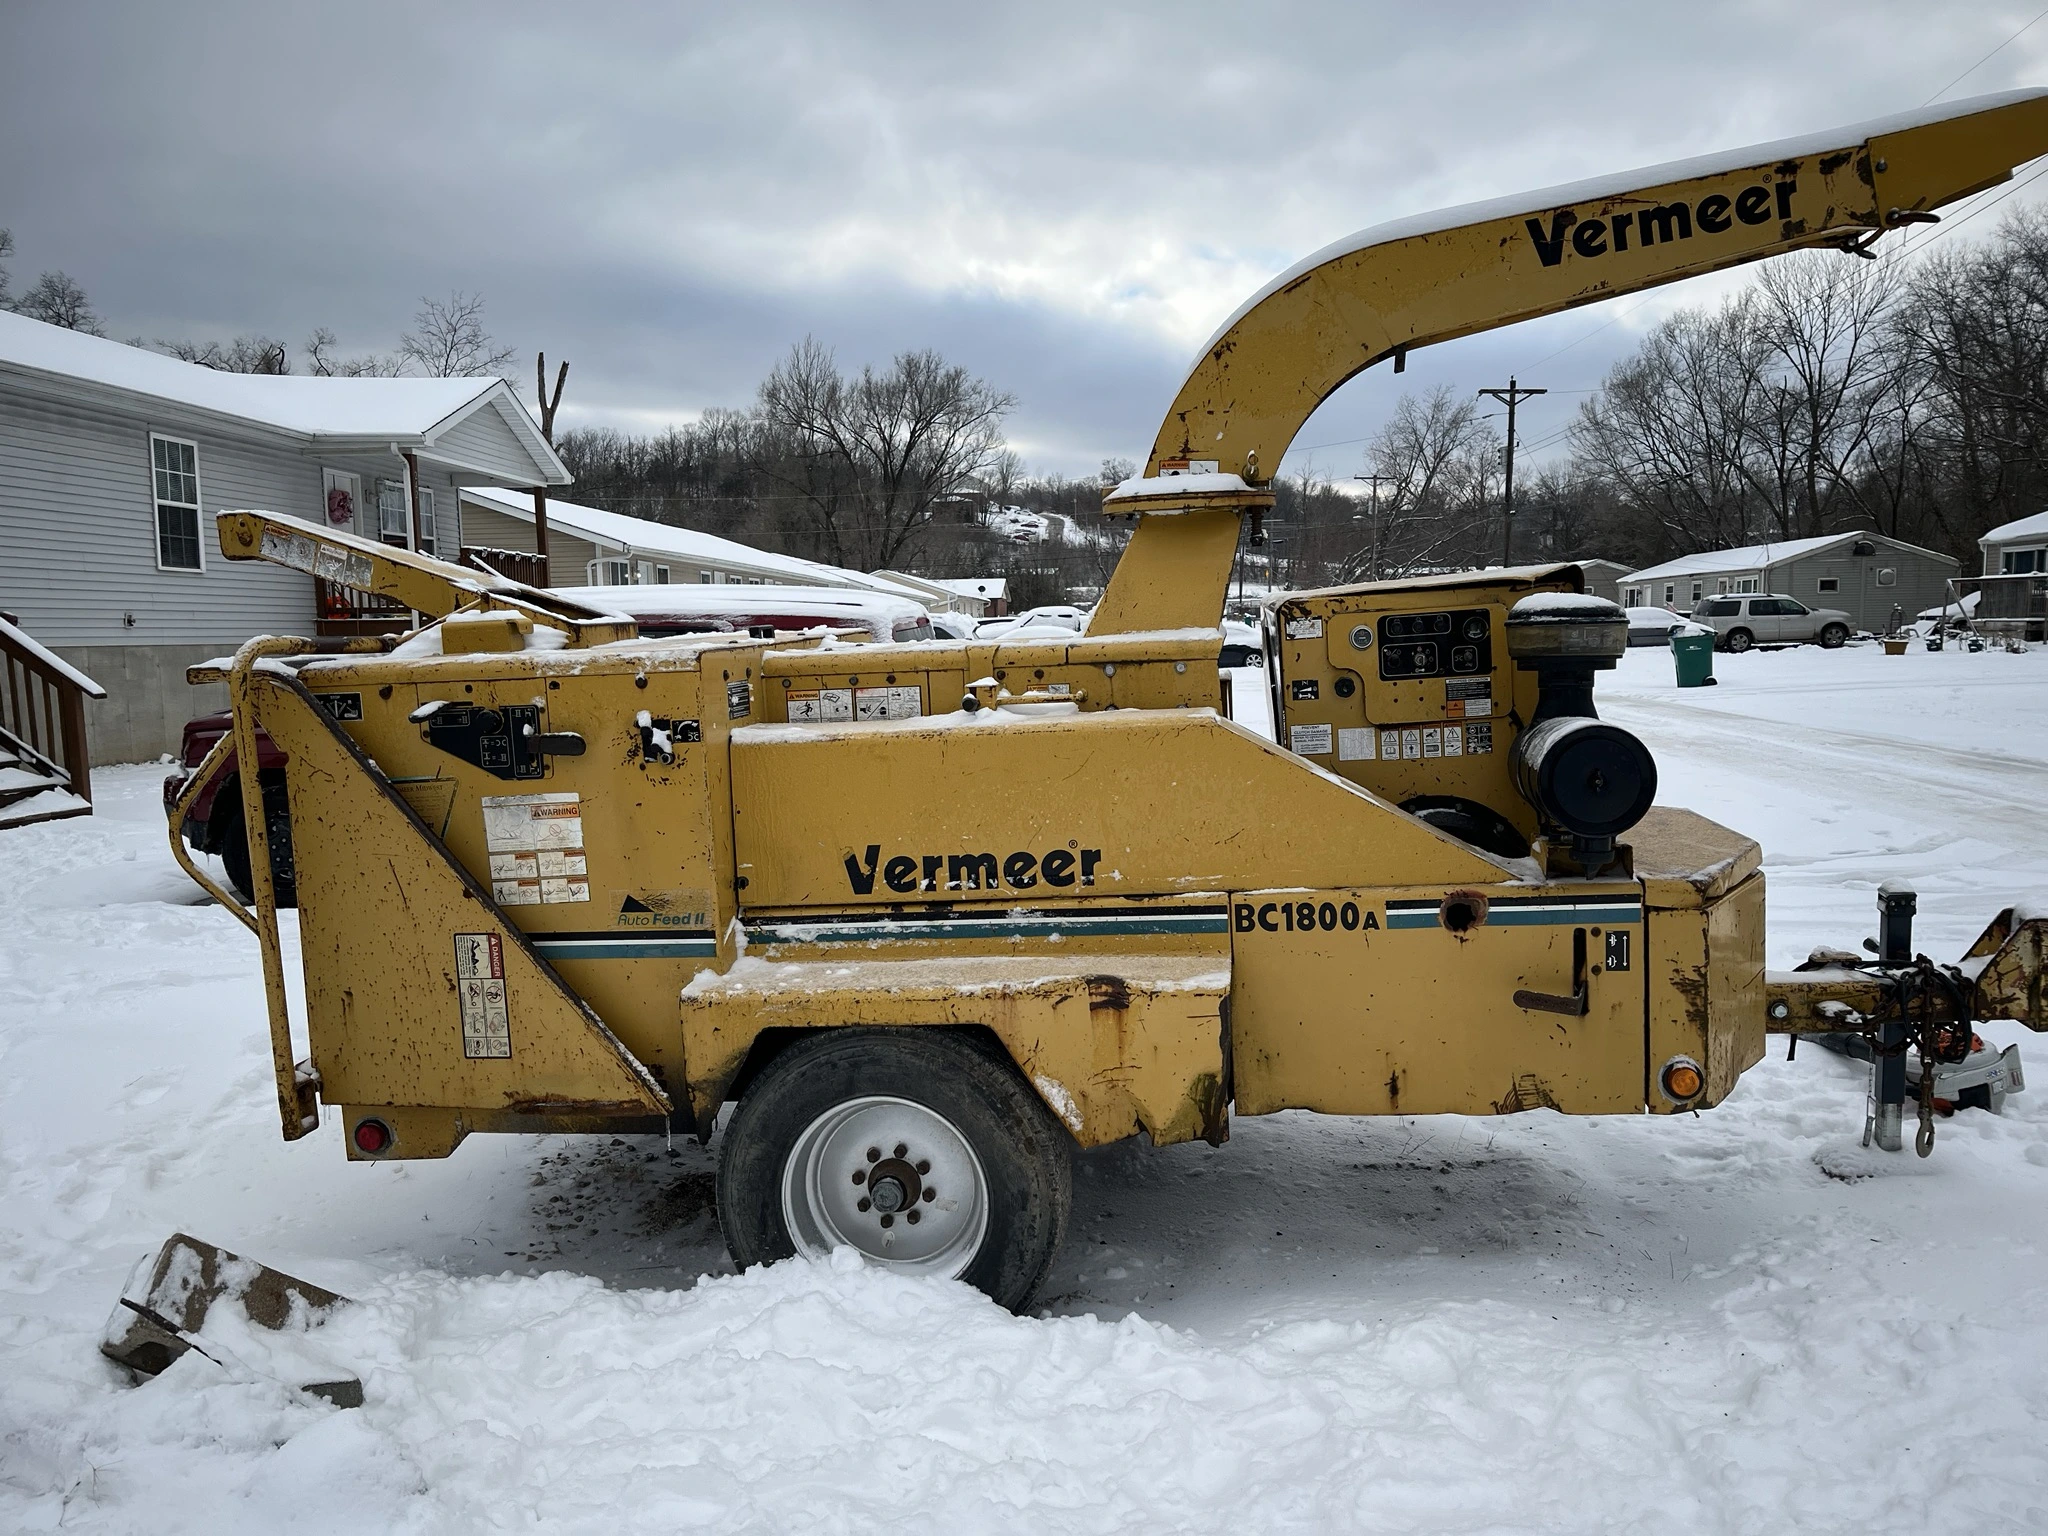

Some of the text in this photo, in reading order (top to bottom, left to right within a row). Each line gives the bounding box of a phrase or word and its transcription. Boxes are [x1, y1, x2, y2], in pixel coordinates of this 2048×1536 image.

[1525, 179, 1798, 268] Vermeer
[540, 807, 578, 816] WARNING
[843, 844, 1102, 895] Vermeer
[618, 914, 650, 926] Auto
[653, 912, 692, 925] Feed
[1235, 902, 1381, 932] BC1800A
[492, 946, 501, 978] DANGER
